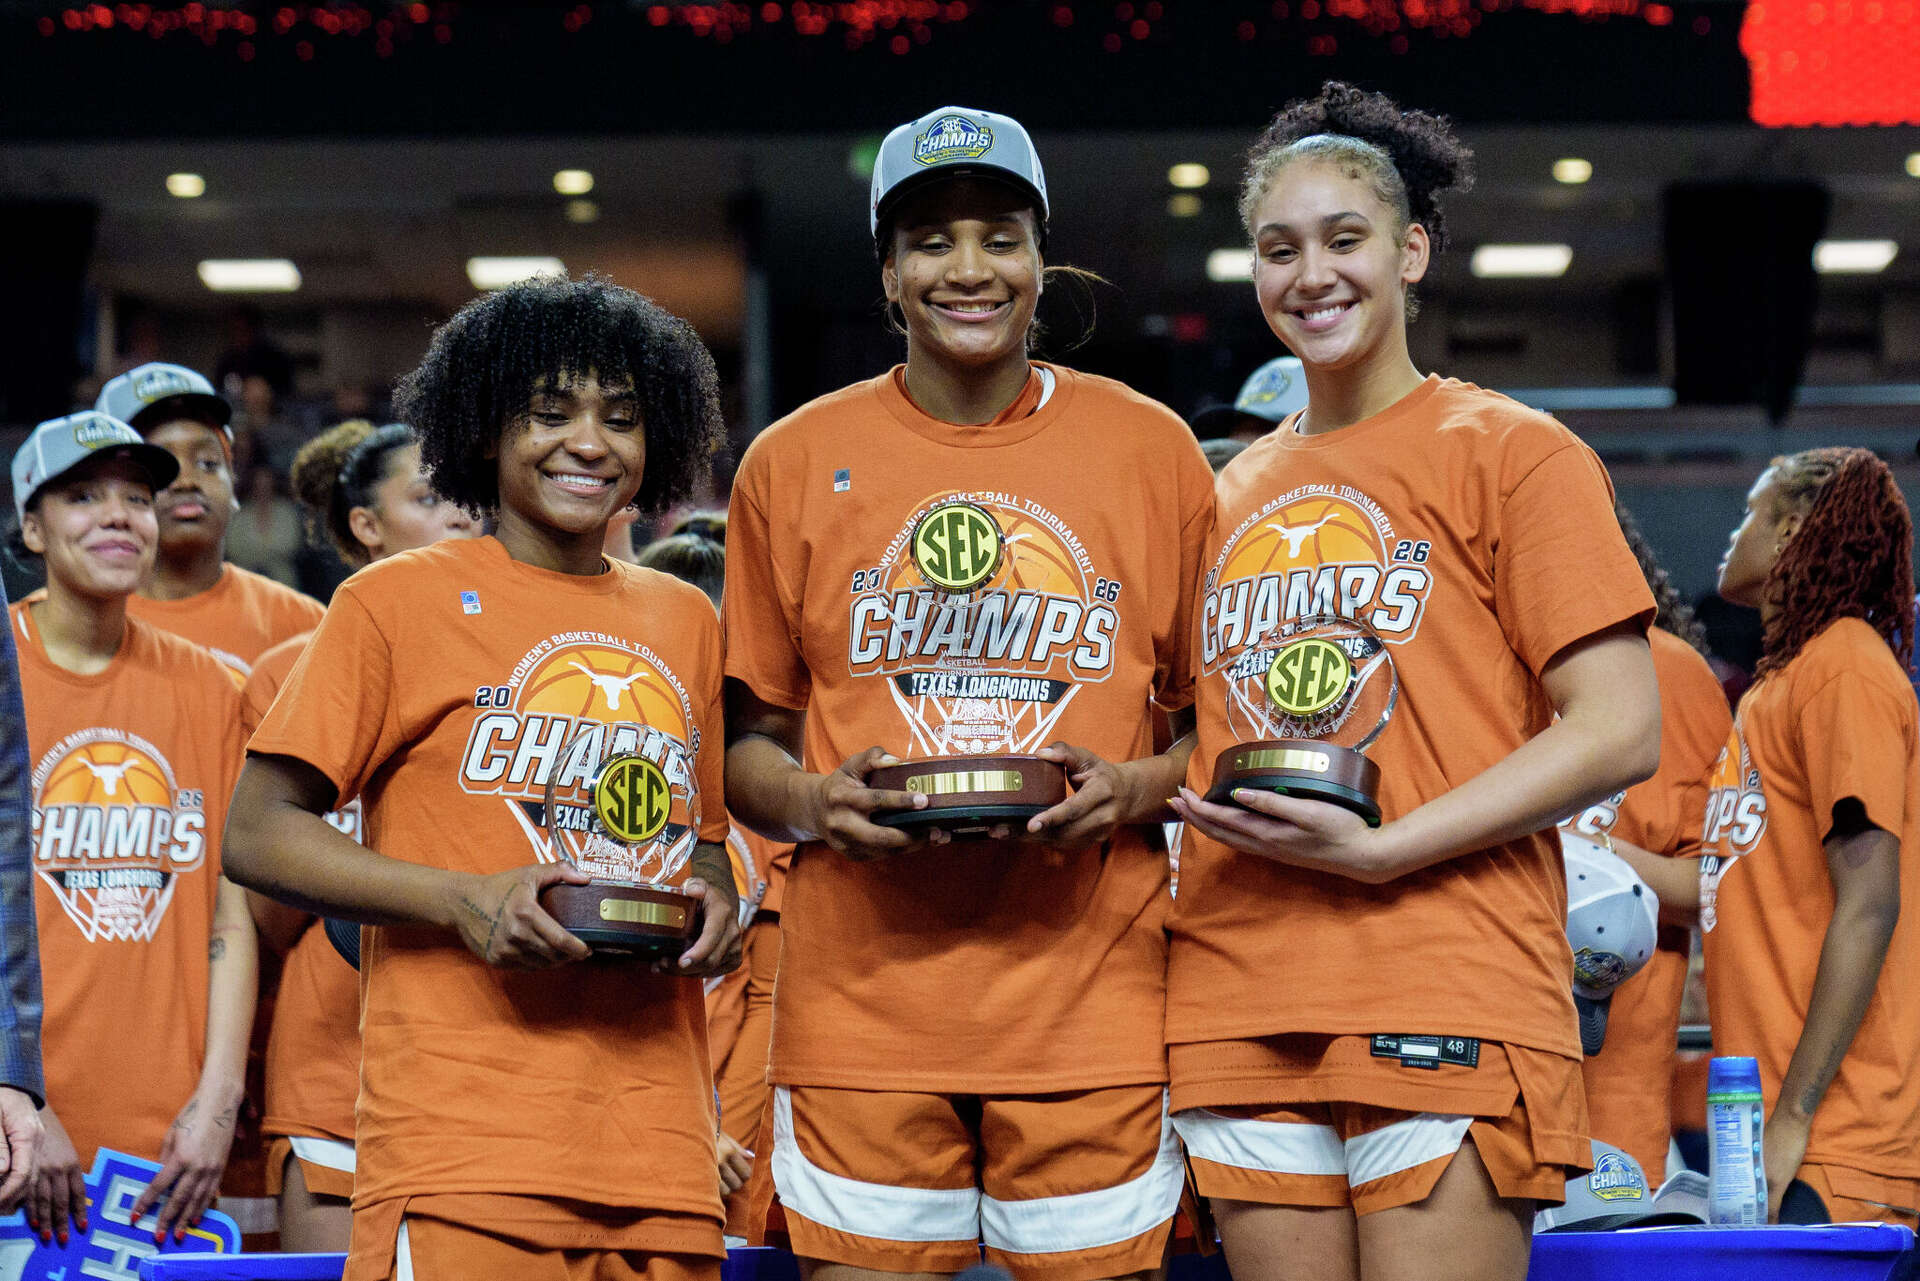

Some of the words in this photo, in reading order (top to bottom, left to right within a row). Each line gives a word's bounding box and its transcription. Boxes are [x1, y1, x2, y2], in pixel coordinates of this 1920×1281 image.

[919, 133, 988, 156] CHAMPS
[922, 511, 992, 582] SEC
[1024, 498, 1095, 575] TOURNAMENT
[1215, 512, 1259, 565] WOMEN'S
[1262, 483, 1336, 514] BASKETBALL
[1339, 484, 1396, 539] TOURNAMENT
[1393, 540, 1431, 564] 26
[852, 568, 881, 593] 20
[1095, 577, 1121, 603] 26
[850, 592, 1116, 670] CHAMPS
[1202, 565, 1428, 666] CHAMPS
[475, 687, 511, 709] 20
[508, 640, 552, 688] WOMEN'S
[551, 631, 630, 649] BASKETBALL
[633, 642, 693, 722] TOURNAMENT
[911, 672, 957, 697] TEXAS
[960, 675, 1051, 702] LONGHORNS
[1274, 644, 1341, 707] SEC
[605, 763, 664, 835] SEC
[1447, 1039, 1465, 1054] 48
